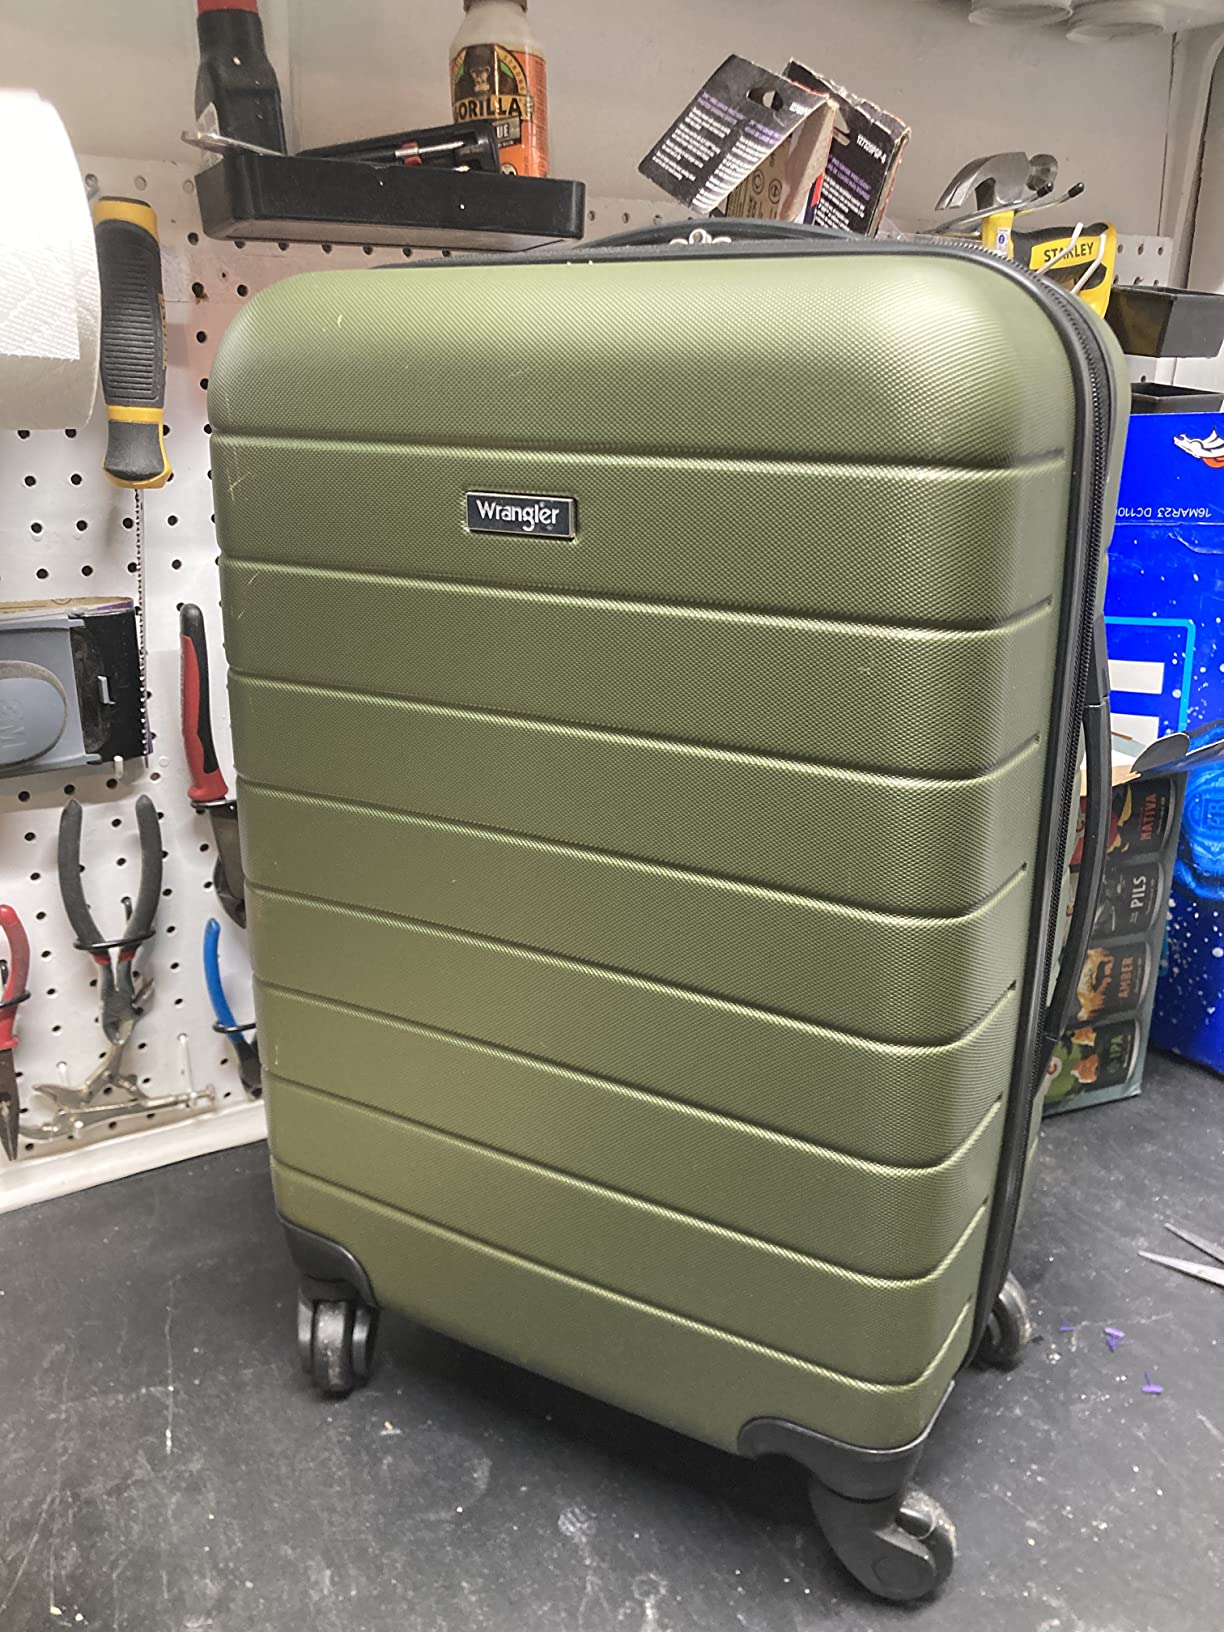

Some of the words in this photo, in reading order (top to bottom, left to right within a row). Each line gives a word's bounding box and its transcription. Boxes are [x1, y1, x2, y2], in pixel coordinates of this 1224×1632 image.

[496, 122, 510, 139] UE
[476, 499, 560, 532] Wrangler
[1117, 507, 1152, 518] DC110
[1157, 507, 1212, 518] 16MAR23
[1140, 793, 1158, 841] NATIVA
[1130, 875, 1147, 909] PILS
[1118, 956, 1134, 998] AMBER
